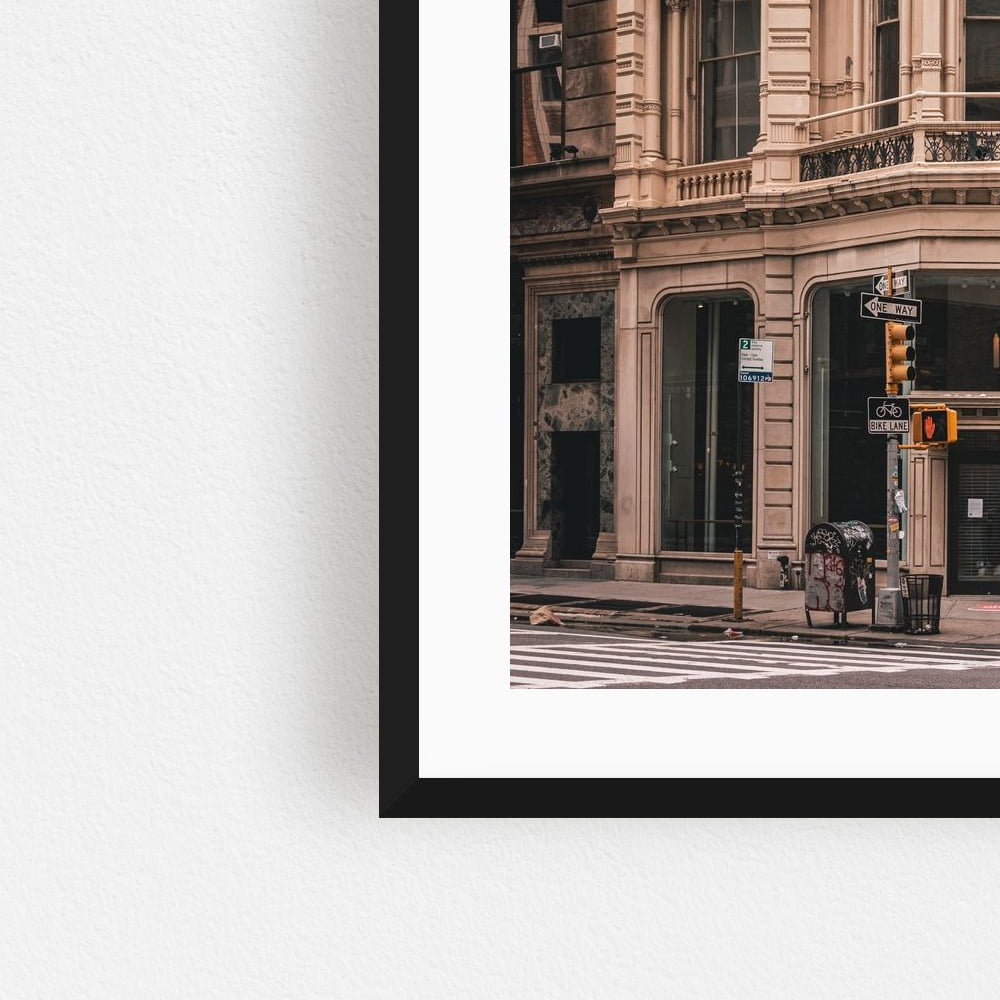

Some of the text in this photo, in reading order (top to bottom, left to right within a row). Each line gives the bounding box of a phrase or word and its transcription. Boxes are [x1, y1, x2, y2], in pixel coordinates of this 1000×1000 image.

[870, 301, 913, 315] ONE WAY
[742, 340, 749, 349] 2
[870, 421, 908, 430] BIKE LANE
